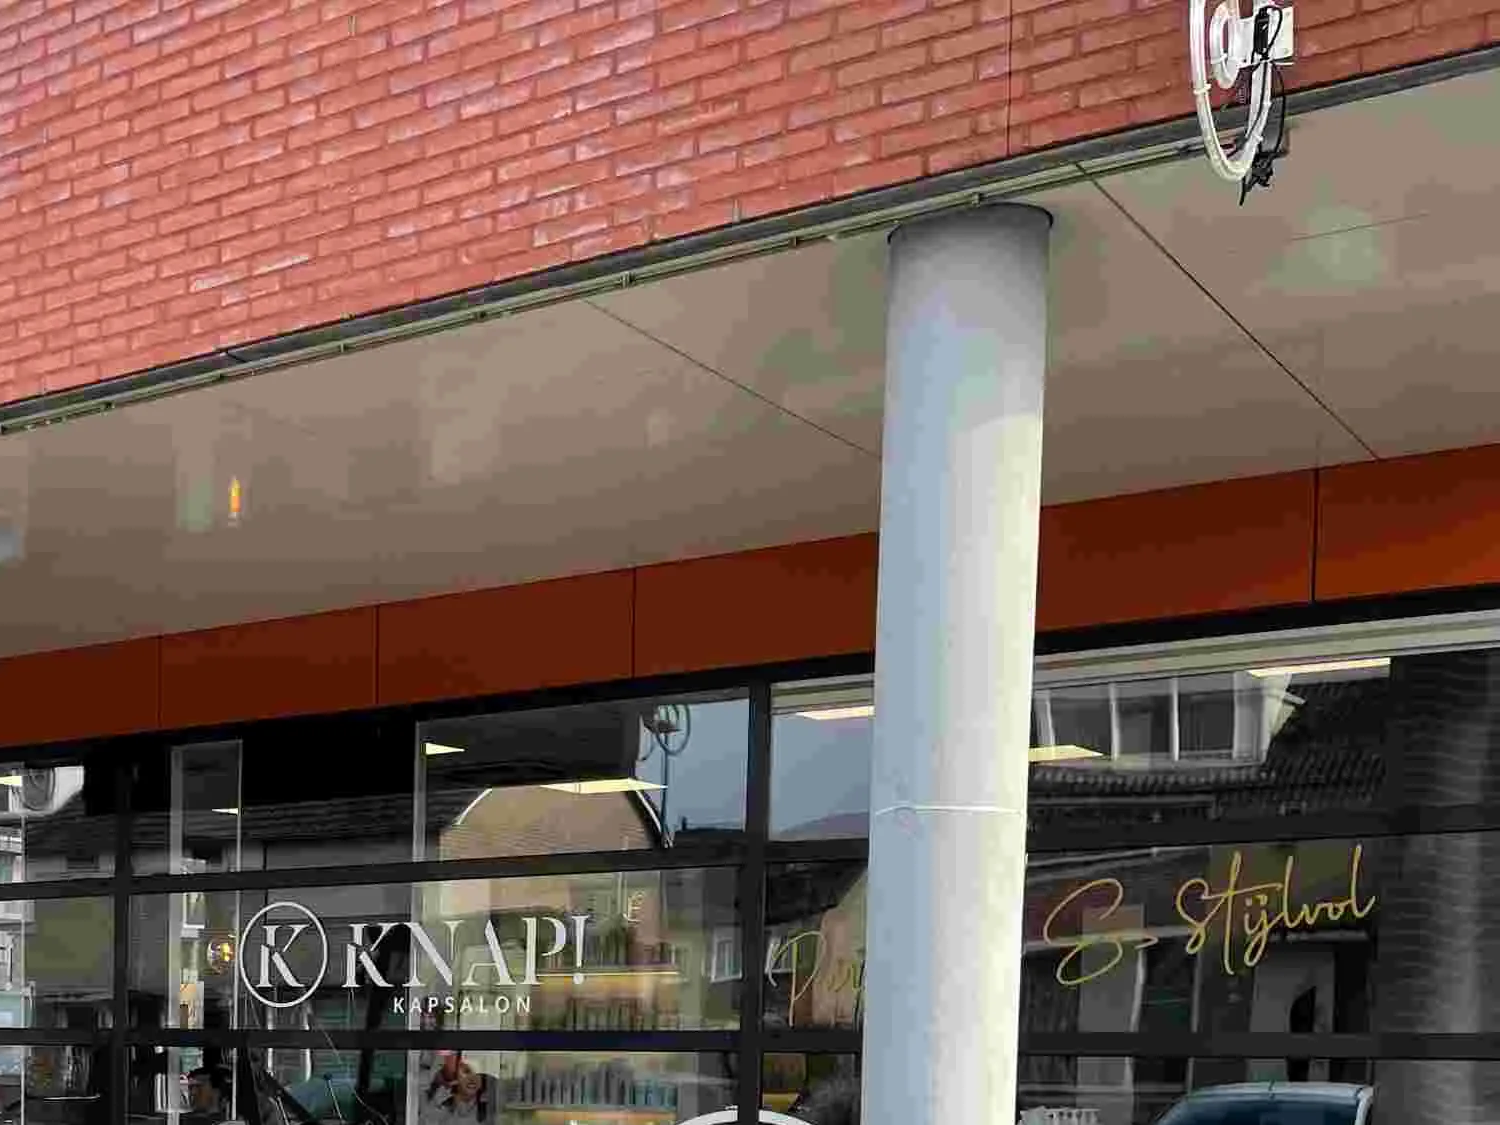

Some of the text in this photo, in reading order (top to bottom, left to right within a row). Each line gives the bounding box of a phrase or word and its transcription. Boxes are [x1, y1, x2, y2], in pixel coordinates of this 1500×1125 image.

[1176, 844, 1376, 975] Stijlvol
[341, 914, 590, 988] KNAP!
[392, 995, 531, 1014] KAPSALON
